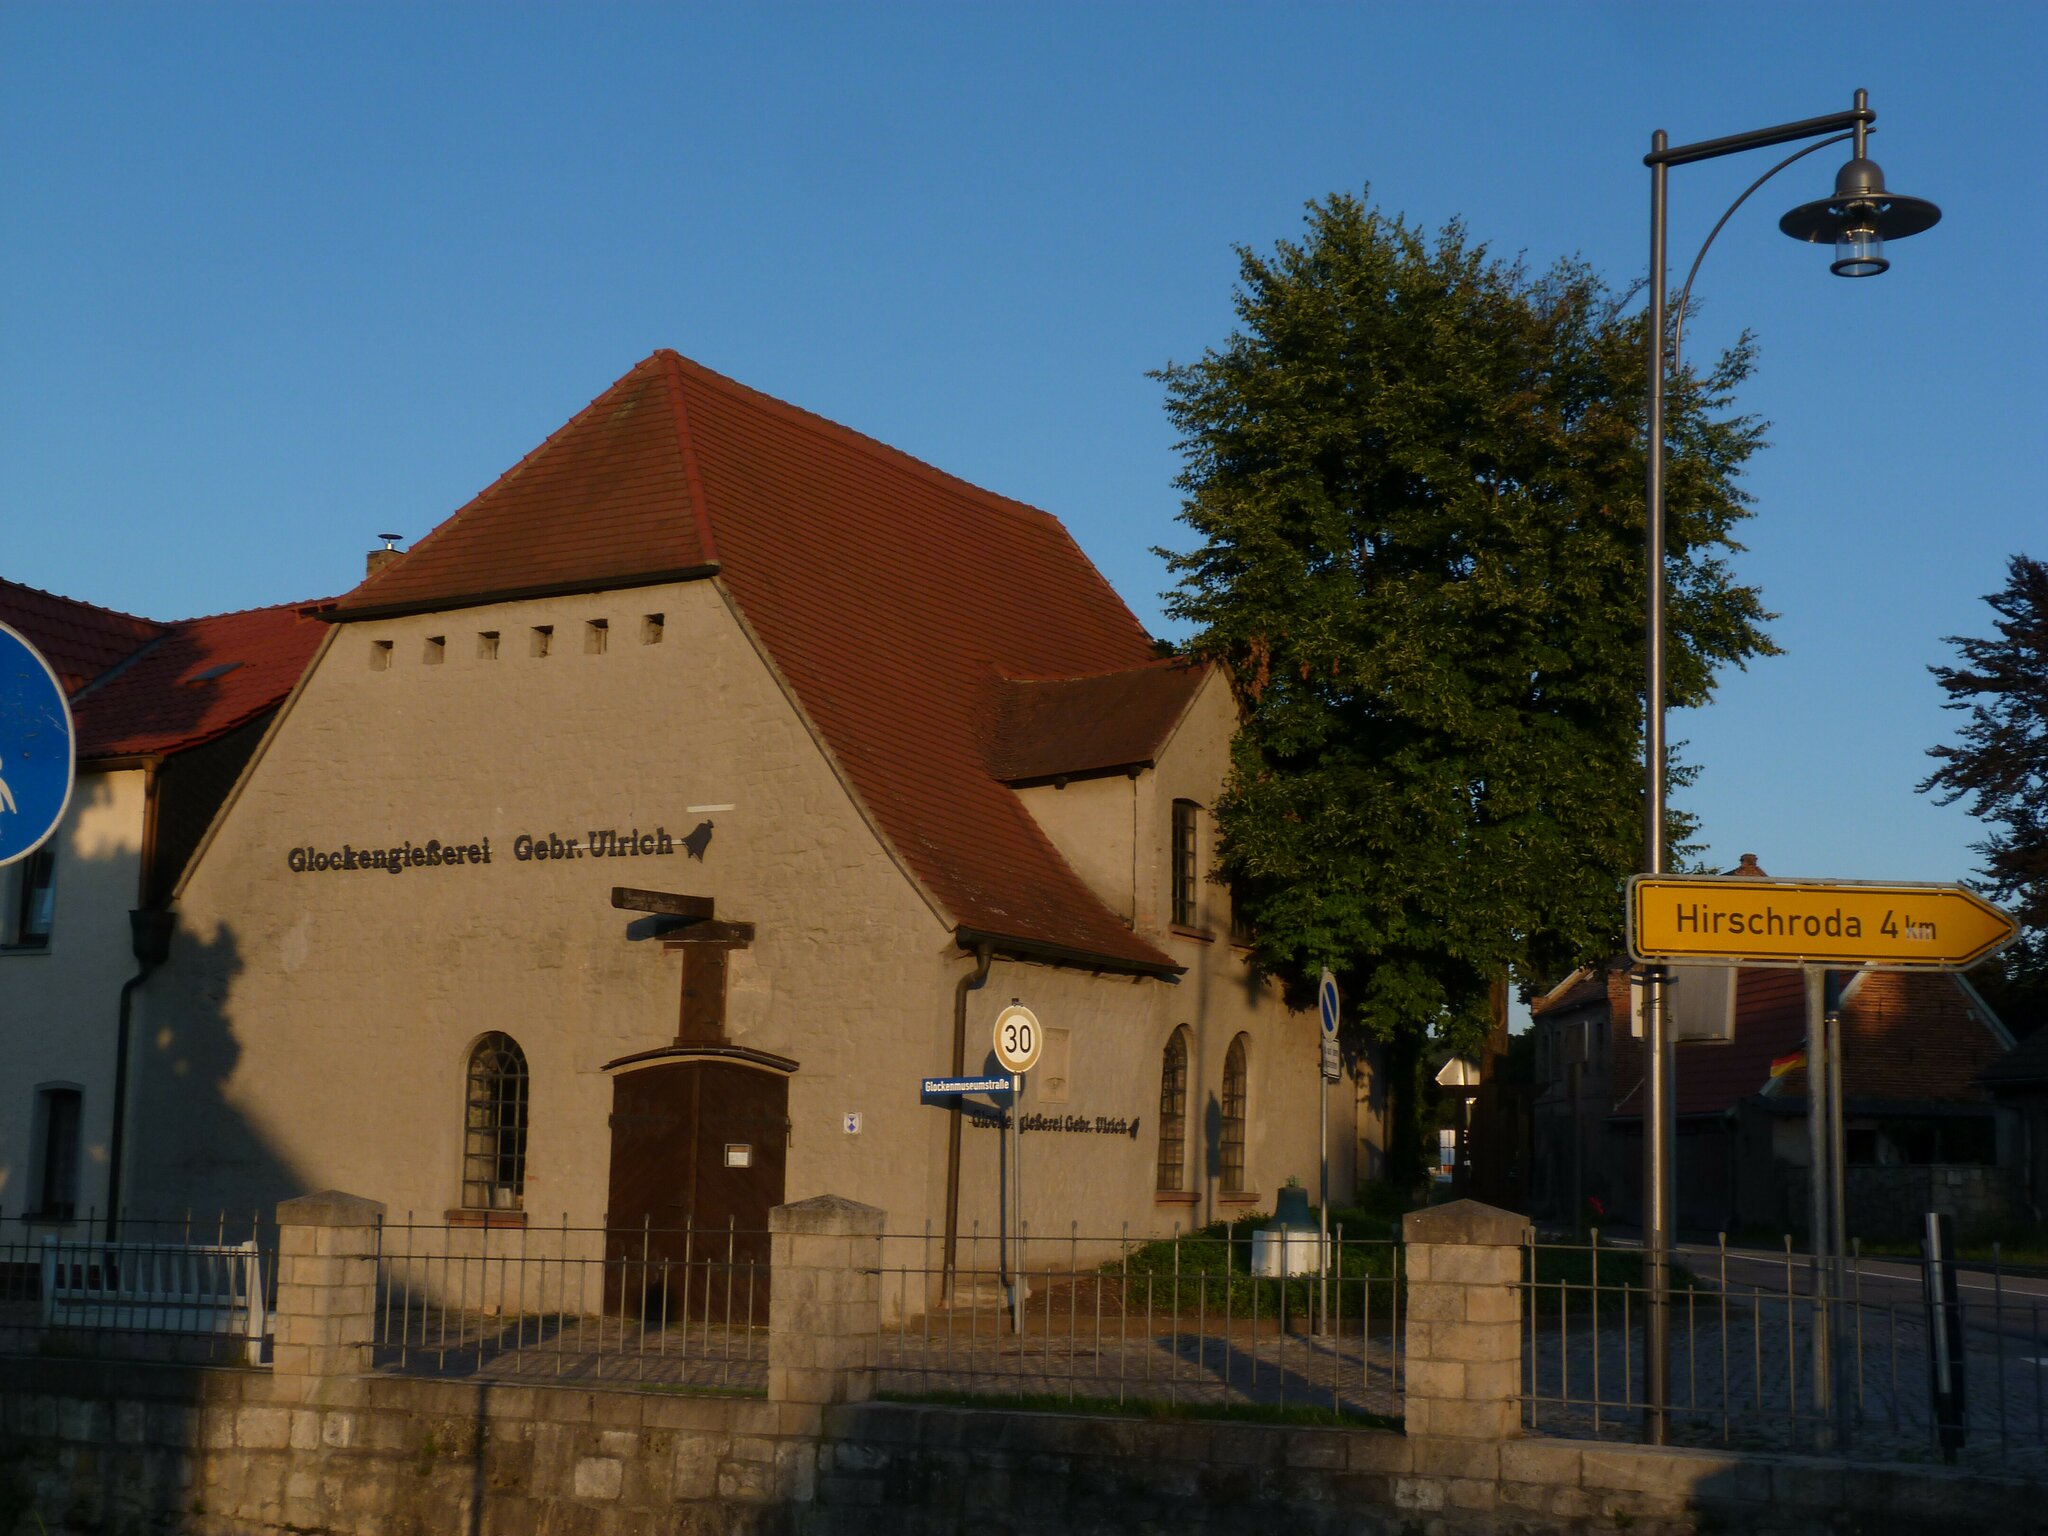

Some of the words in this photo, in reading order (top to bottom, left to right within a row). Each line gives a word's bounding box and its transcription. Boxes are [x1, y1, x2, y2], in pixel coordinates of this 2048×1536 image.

[287, 836, 492, 875] Glockengießerei
[513, 832, 583, 861] Gebr.
[588, 827, 674, 857] Ulrich
[1676, 903, 1862, 938] Hirschroda
[1879, 909, 1899, 939] 4
[1904, 914, 1937, 941] km
[1005, 1024, 1031, 1053] 30
[924, 1078, 1010, 1092] Glockenmuseumstraße
[1065, 1115, 1092, 1133] Gebr.
[1095, 1116, 1127, 1134] Ulrich
